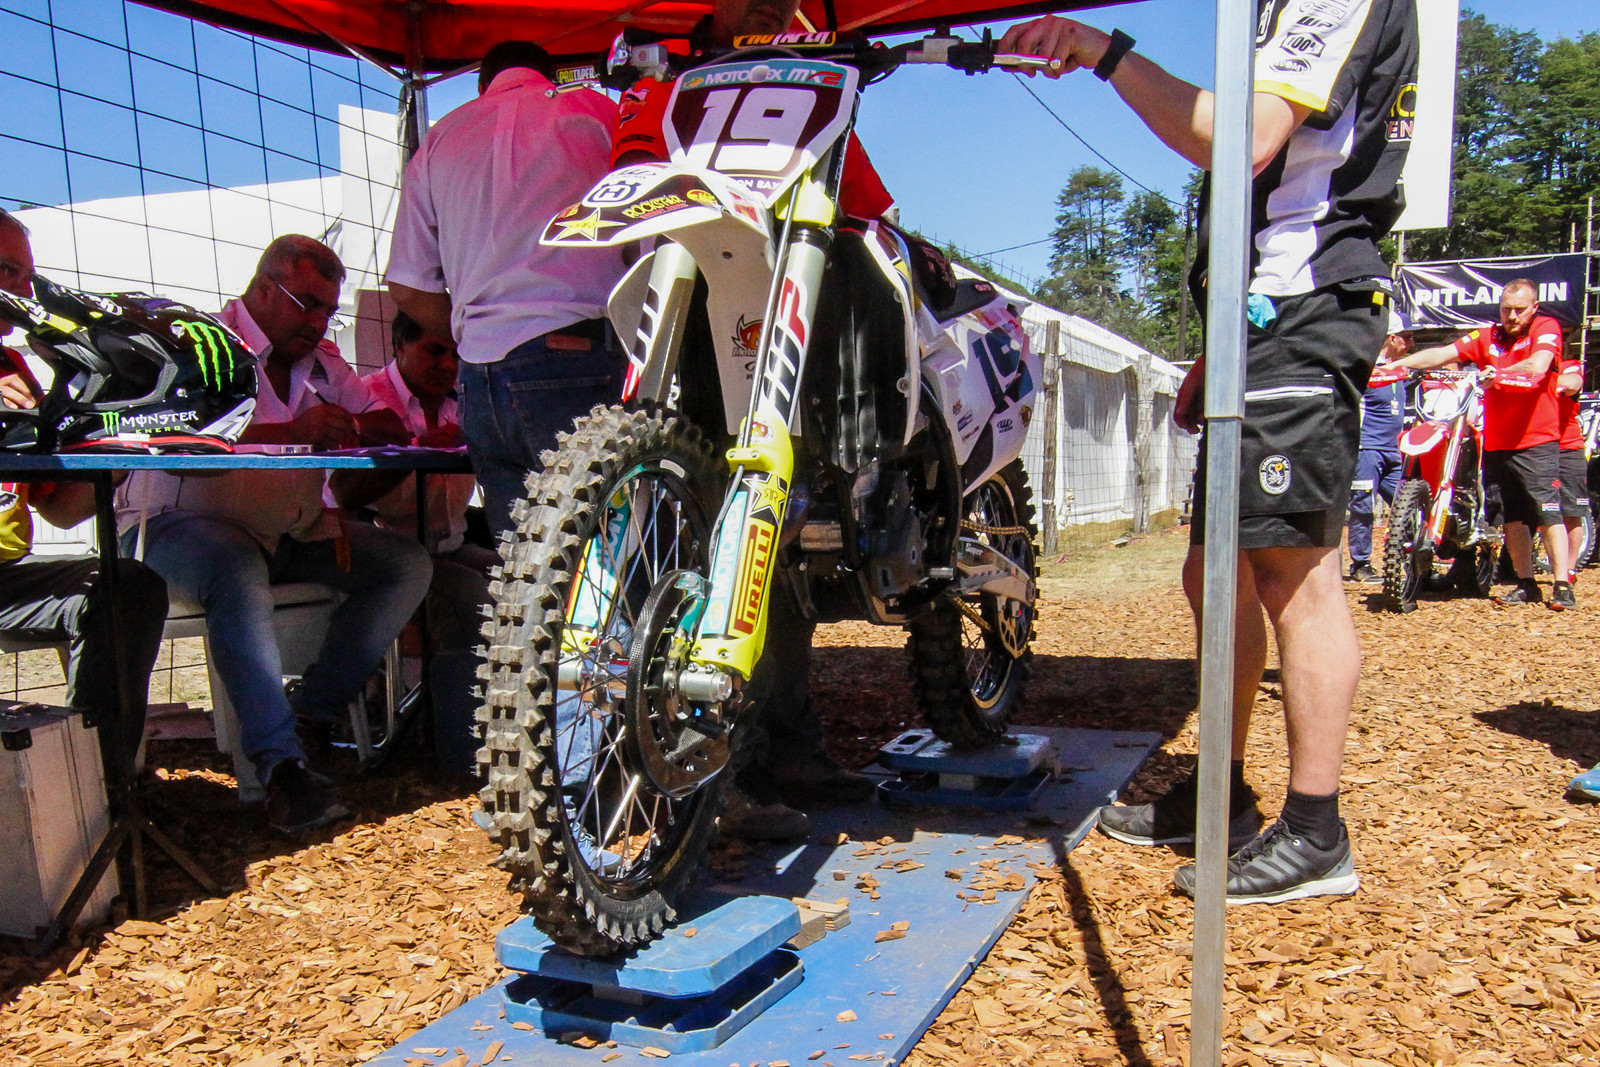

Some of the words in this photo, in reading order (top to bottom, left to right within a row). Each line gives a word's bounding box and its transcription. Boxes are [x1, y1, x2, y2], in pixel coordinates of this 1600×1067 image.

[705, 69, 784, 85] MOTOEX
[786, 68, 844, 86] MX2
[687, 87, 818, 172] 19
[621, 194, 687, 219] ROCKSTAR
[1414, 286, 1504, 307] PITLA
[1538, 282, 1568, 302] IN
[121, 411, 200, 427] MONSTER
[135, 425, 190, 434] ENERGY
[734, 523, 771, 636] PIRELLI
